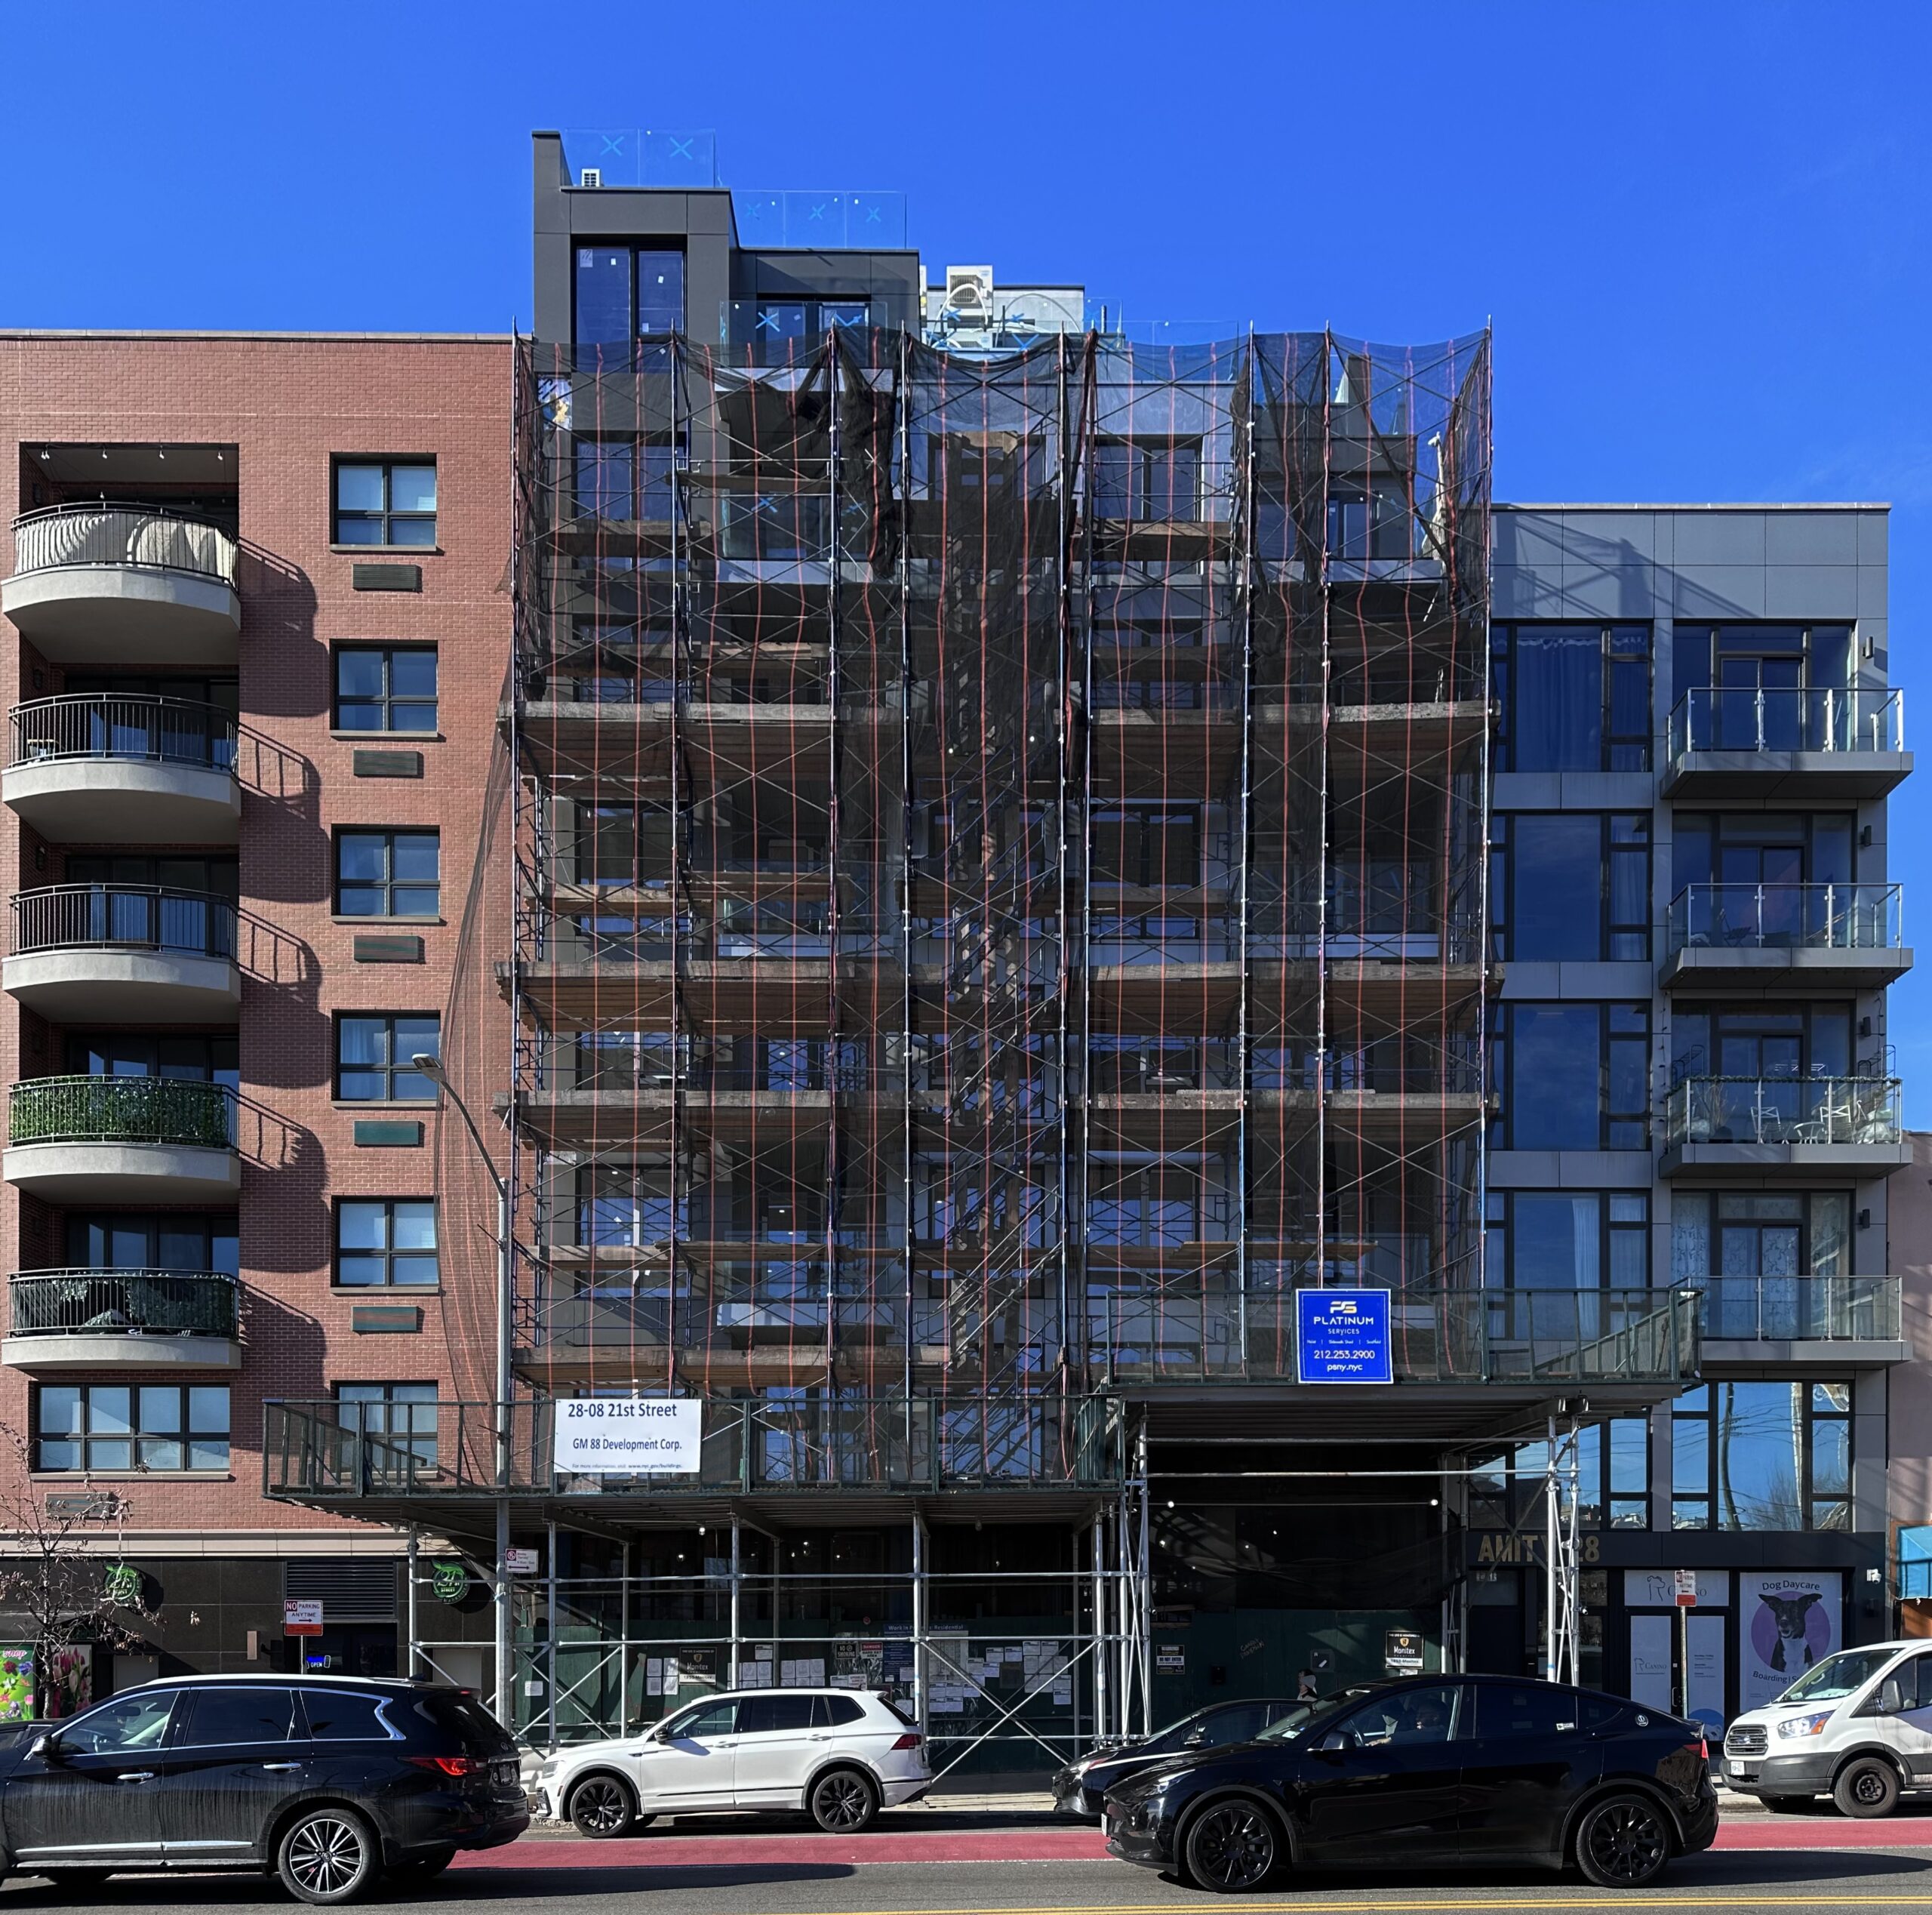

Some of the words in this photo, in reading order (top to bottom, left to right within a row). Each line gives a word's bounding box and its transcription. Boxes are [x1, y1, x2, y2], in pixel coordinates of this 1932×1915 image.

[1314, 1316, 1374, 1325] PLATINUM
[1314, 1350, 1375, 1359] 212.253.2900
[1327, 1364, 1363, 1372] psny.nyc
[568, 1403, 604, 1418] 28-08
[608, 1403, 635, 1417] 21st
[638, 1402, 678, 1417] Street
[573, 1438, 588, 1449] GM
[590, 1439, 601, 1449] 88
[603, 1438, 658, 1452] Development
[660, 1439, 682, 1452] Corp.
[1762, 1581, 1782, 1591] Dog
[1783, 1580, 1820, 1590] Daycare
[286, 1602, 297, 1611] NO
[1393, 1646, 1416, 1655] Monitex
[1752, 1670, 1787, 1684] Boarding
